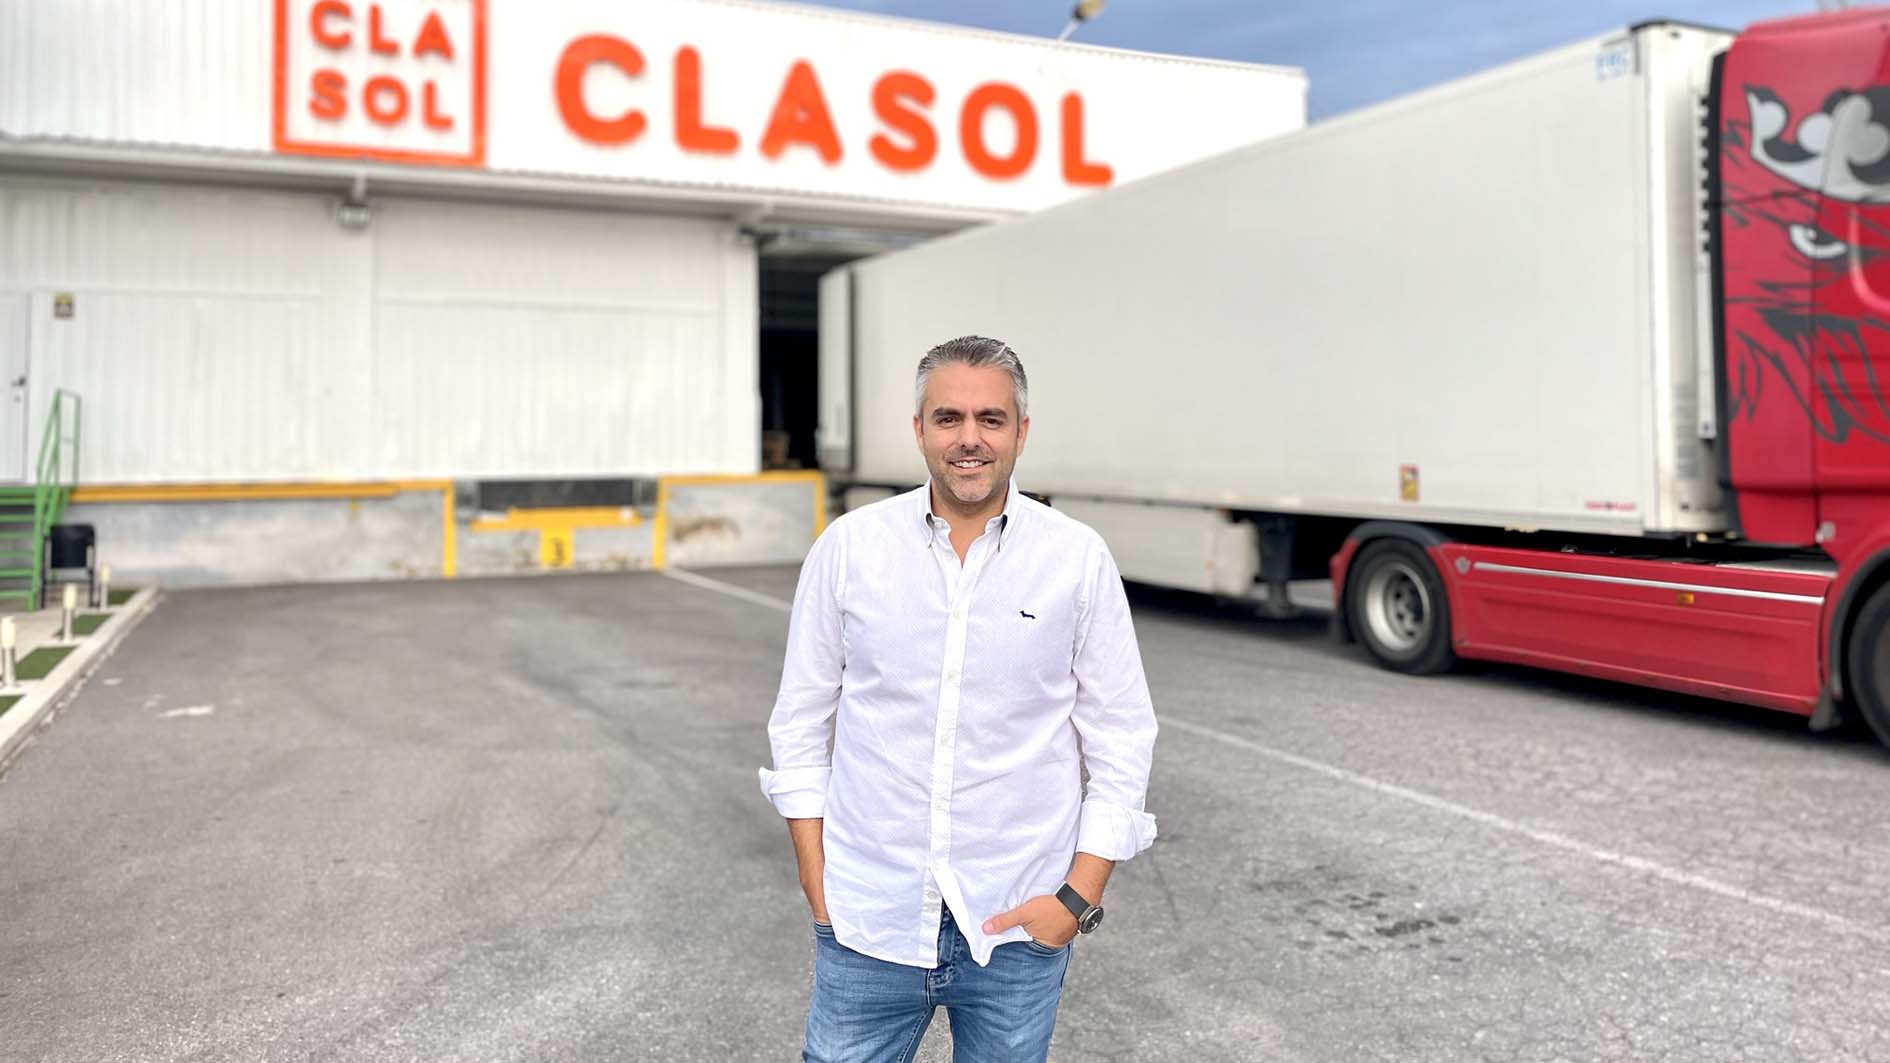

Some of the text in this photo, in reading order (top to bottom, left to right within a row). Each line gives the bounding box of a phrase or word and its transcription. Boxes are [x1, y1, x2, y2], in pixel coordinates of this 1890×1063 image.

[309, 0, 455, 61] CLA
[308, 69, 455, 132] SOL
[553, 33, 1114, 188] CLASOL
